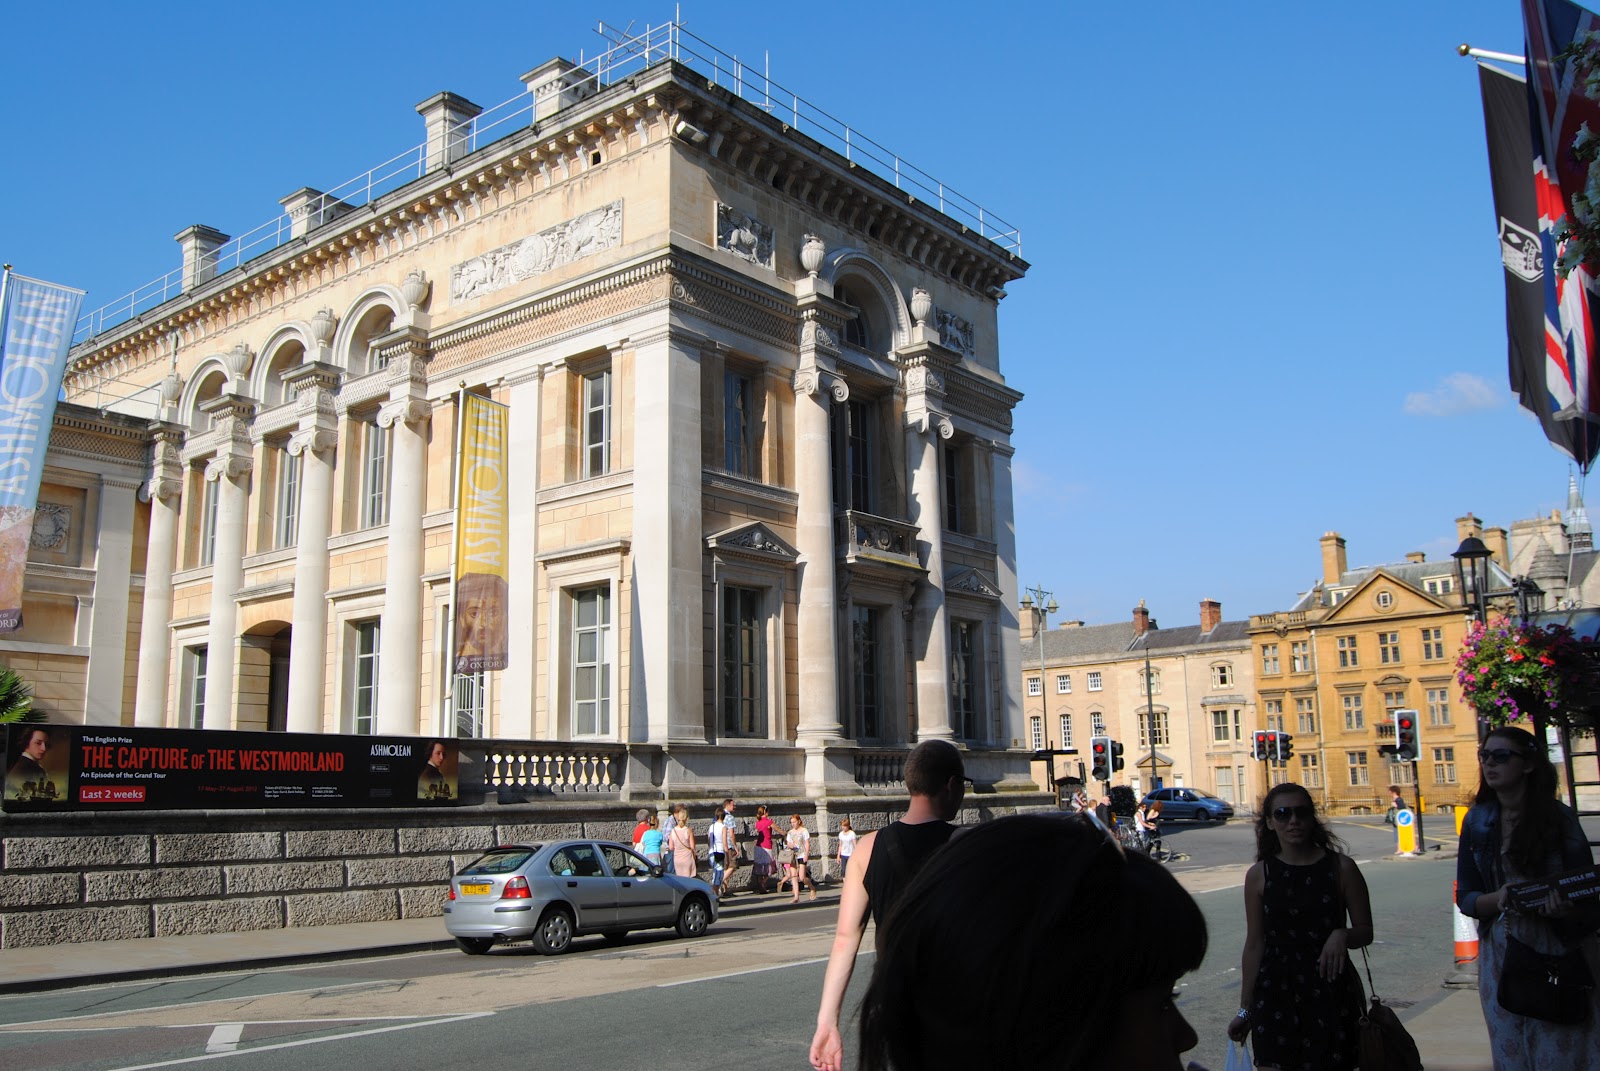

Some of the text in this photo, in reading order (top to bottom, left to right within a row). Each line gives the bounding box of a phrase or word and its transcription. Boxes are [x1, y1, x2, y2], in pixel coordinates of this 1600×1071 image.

[0, 287, 71, 498] ASHMOLEAN
[464, 402, 502, 567] ASHMOLEAN
[470, 661, 506, 669] OXFORD
[82, 735, 94, 743] The
[95, 736, 117, 744] English
[370, 744, 411, 757] ASHMOLEAN
[82, 746, 345, 772] THE CAPTURE OF THE WESTMORLAND
[91, 772, 115, 780] Episode
[82, 789, 143, 799] Last 2 weeks
